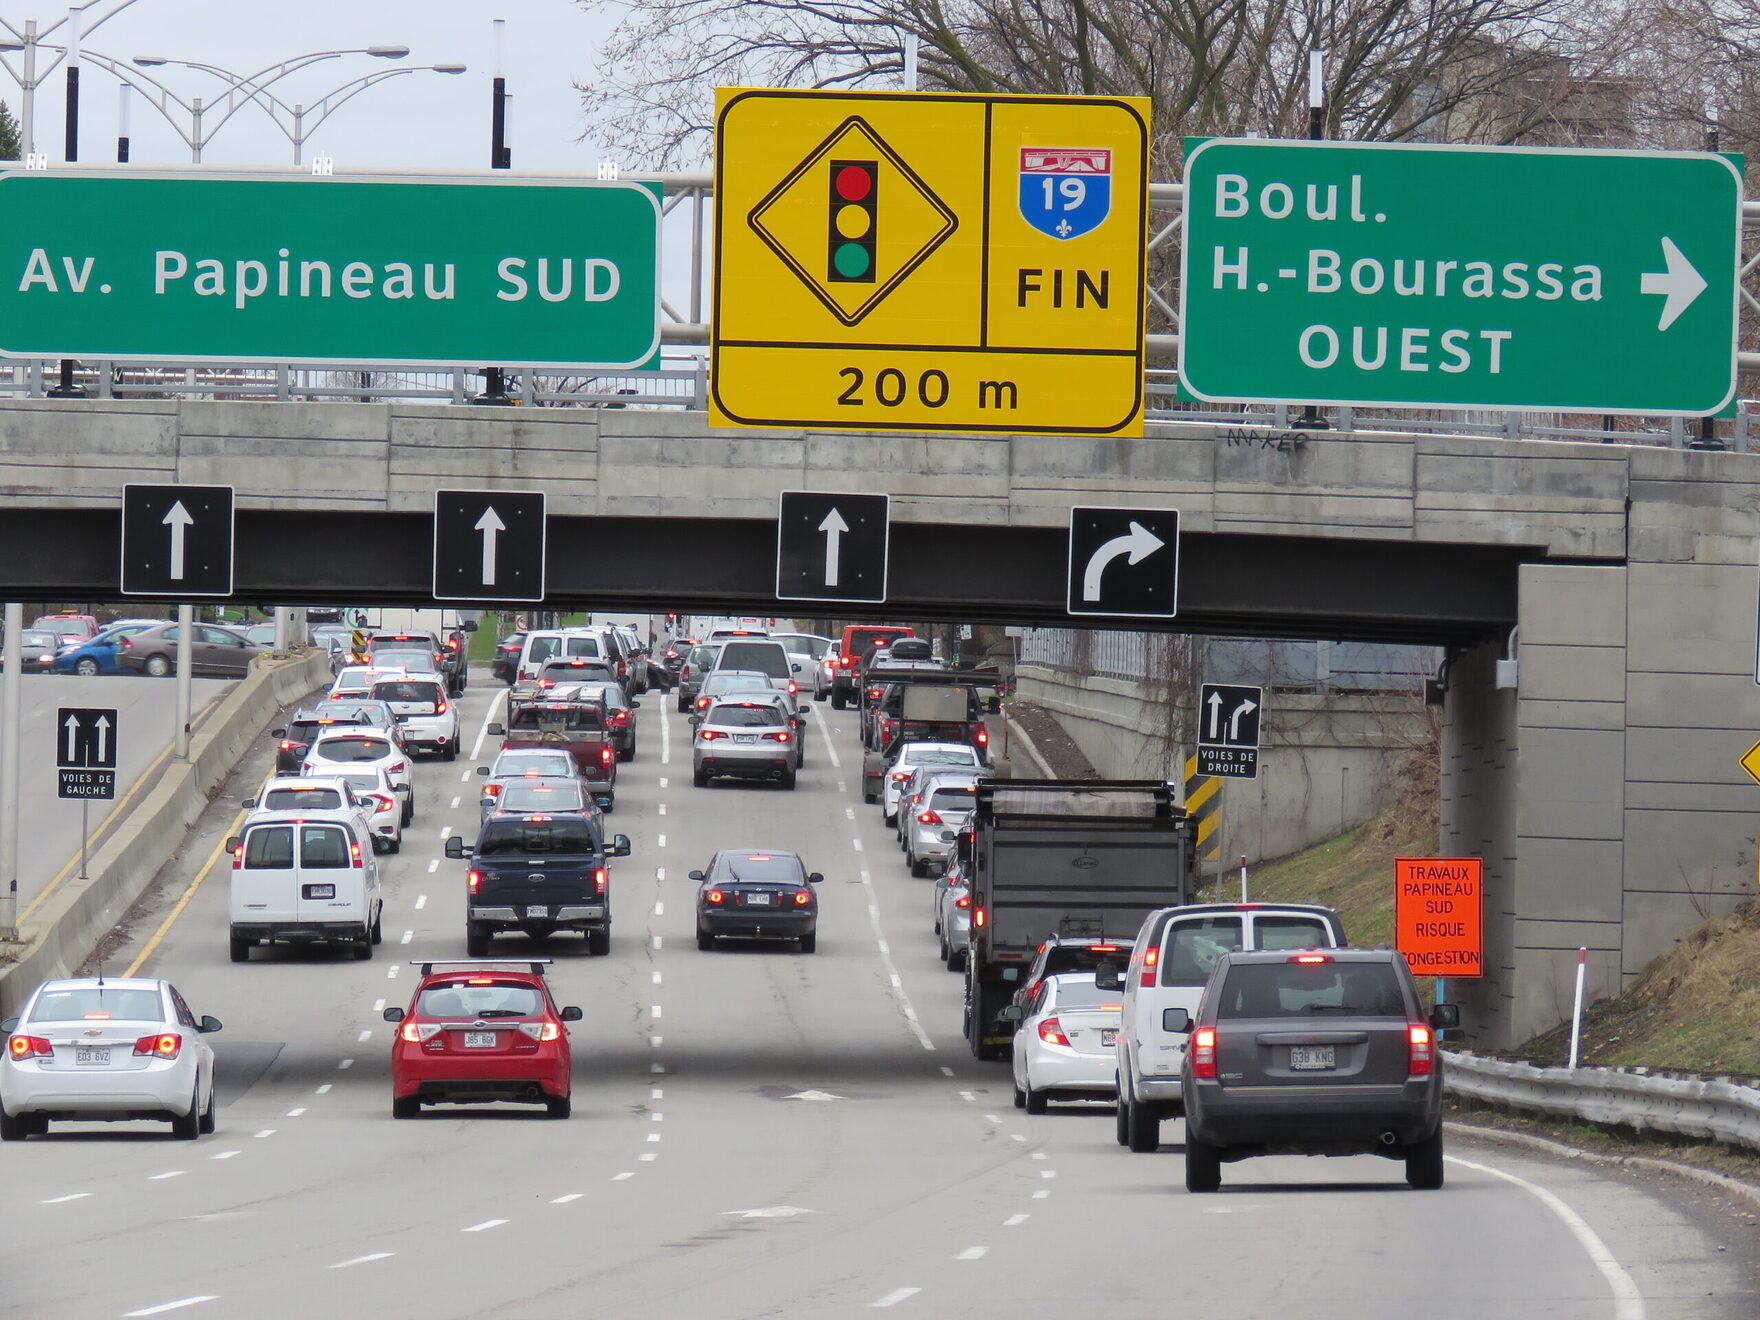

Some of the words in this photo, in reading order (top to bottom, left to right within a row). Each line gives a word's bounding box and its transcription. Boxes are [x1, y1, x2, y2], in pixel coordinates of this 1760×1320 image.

[1043, 177, 1086, 211] 19
[1215, 173, 1387, 222] Boul.
[18, 248, 112, 294] Av.
[155, 248, 455, 309] Papineau
[496, 257, 621, 303] SUD
[1213, 245, 1603, 302] H.-Bourassa
[1017, 268, 1109, 309] FIN
[1298, 324, 1513, 374] OUEST
[837, 366, 950, 408] 200
[978, 380, 1018, 409] m
[1201, 750, 1233, 761] VOIES
[1240, 752, 1254, 762] DE
[1208, 762, 1246, 774] DROITE
[62, 773, 92, 783] VOIES
[98, 774, 111, 784] DE
[66, 785, 106, 795] GAUCHE
[1408, 866, 1470, 881] TRAVAUX
[1403, 882, 1473, 897] PAPINEAU
[1425, 900, 1454, 914] SUD
[1415, 922, 1466, 937] RISQUE
[1315, 1051, 1334, 1064] KNG
